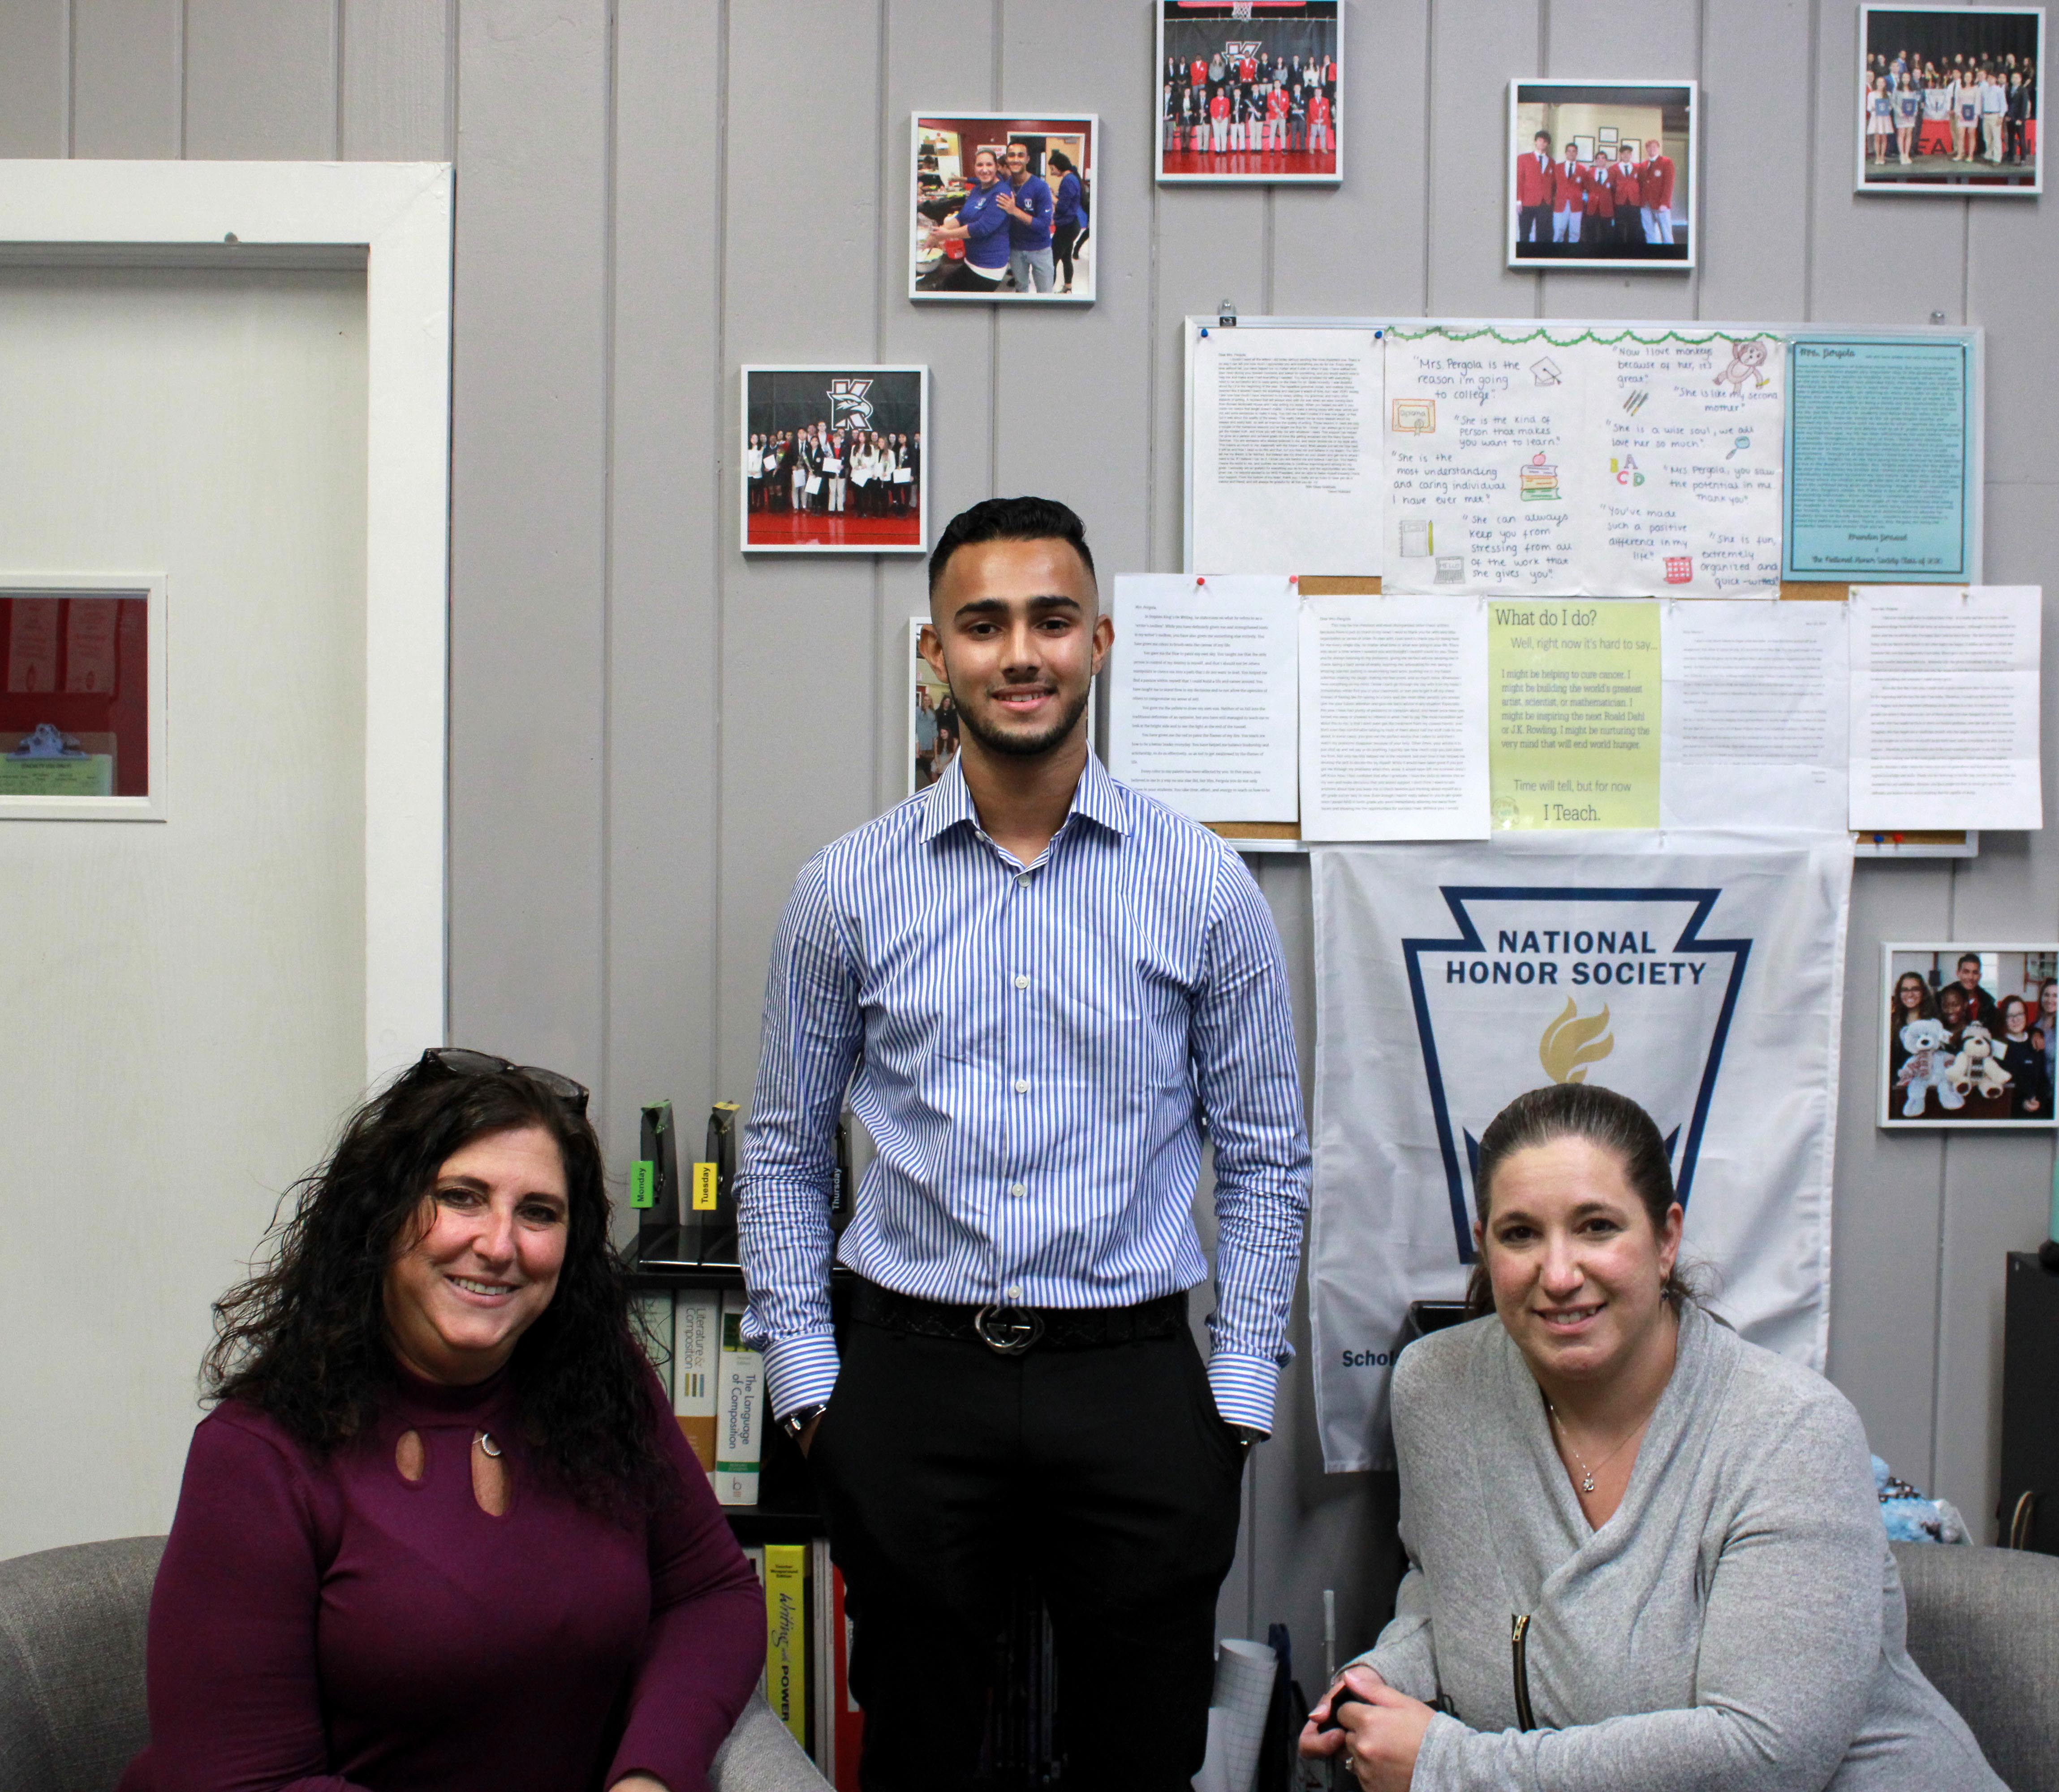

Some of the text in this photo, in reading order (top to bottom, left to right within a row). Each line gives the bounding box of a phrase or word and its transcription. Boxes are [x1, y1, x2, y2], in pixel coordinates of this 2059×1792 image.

[1447, 360, 1520, 376] Pergola is the
[1418, 375, 1508, 390] reason going
[1435, 390, 1447, 399] to
[1541, 416, 1551, 424] of
[1460, 428, 1488, 436] person
[1459, 439, 1477, 448] you
[1482, 439, 1507, 447] want
[1419, 453, 1452, 462] is the
[1425, 467, 1498, 480] understanding
[1394, 480, 1506, 494] and caring individual
[1402, 495, 1426, 504] have
[1436, 496, 1456, 504] ever
[1525, 514, 1568, 526] always
[1499, 531, 1516, 543] you
[1523, 529, 1551, 538] from
[1471, 544, 1518, 556] stressing
[1525, 543, 1551, 555] from
[1487, 558, 1506, 567] the
[1495, 569, 1519, 582] gives
[1495, 609, 1597, 626] What do I do?
[1511, 638, 1534, 650] Well,
[1537, 638, 1558, 651] right
[1561, 639, 1582, 650] now
[1584, 638, 1597, 650] it's
[1599, 638, 1620, 650] hard
[1623, 639, 1633, 650] to
[1507, 669, 1529, 681] might
[1530, 670, 1539, 678] be
[1542, 669, 1569, 681] helping
[1571, 670, 1579, 679] to
[1581, 671, 1597, 679] cure
[1502, 683, 1642, 695] might be building the world's greatest
[1560, 698, 1568, 706] or
[1502, 711, 1523, 723] might
[1525, 712, 1535, 720] be
[1537, 712, 1569, 723] inspiring
[1571, 712, 1584, 721] the
[1585, 712, 1602, 721] next
[1565, 725, 1587, 737] might
[1589, 725, 1598, 735] be
[1600, 726, 1636, 737] nurturing
[1637, 726, 1650, 736] the
[1501, 740, 1517, 750] very
[1520, 739, 1539, 748] mind
[1541, 739, 1555, 749] that
[1558, 739, 1572, 749] will
[1573, 739, 1588, 749] end
[1589, 740, 1611, 749] world
[1514, 780, 1537, 791] Time
[1539, 780, 1555, 792] will
[1577, 780, 1593, 792] but
[1595, 780, 1608, 792] for
[1611, 782, 1631, 792] now
[1544, 804, 1601, 822] I Teach.
[1497, 930, 1657, 955] NATIONAL
[1446, 961, 1707, 986] HONOR SOCIETY
[637, 1168, 646, 1202] Monday
[701, 1167, 711, 1203] Tuesday
[832, 1168, 842, 1210] Thursday
[685, 1308, 695, 1370] Composition
[694, 1308, 706, 1368] Literature &
[1343, 1350, 1399, 1367] Schol
[732, 1374, 744, 1386] of
[741, 1374, 756, 1445] The Language
[728, 1387, 741, 1450] Composition
[771, 1593, 796, 1647] Writing
[781, 1665, 789, 1722] POWER
